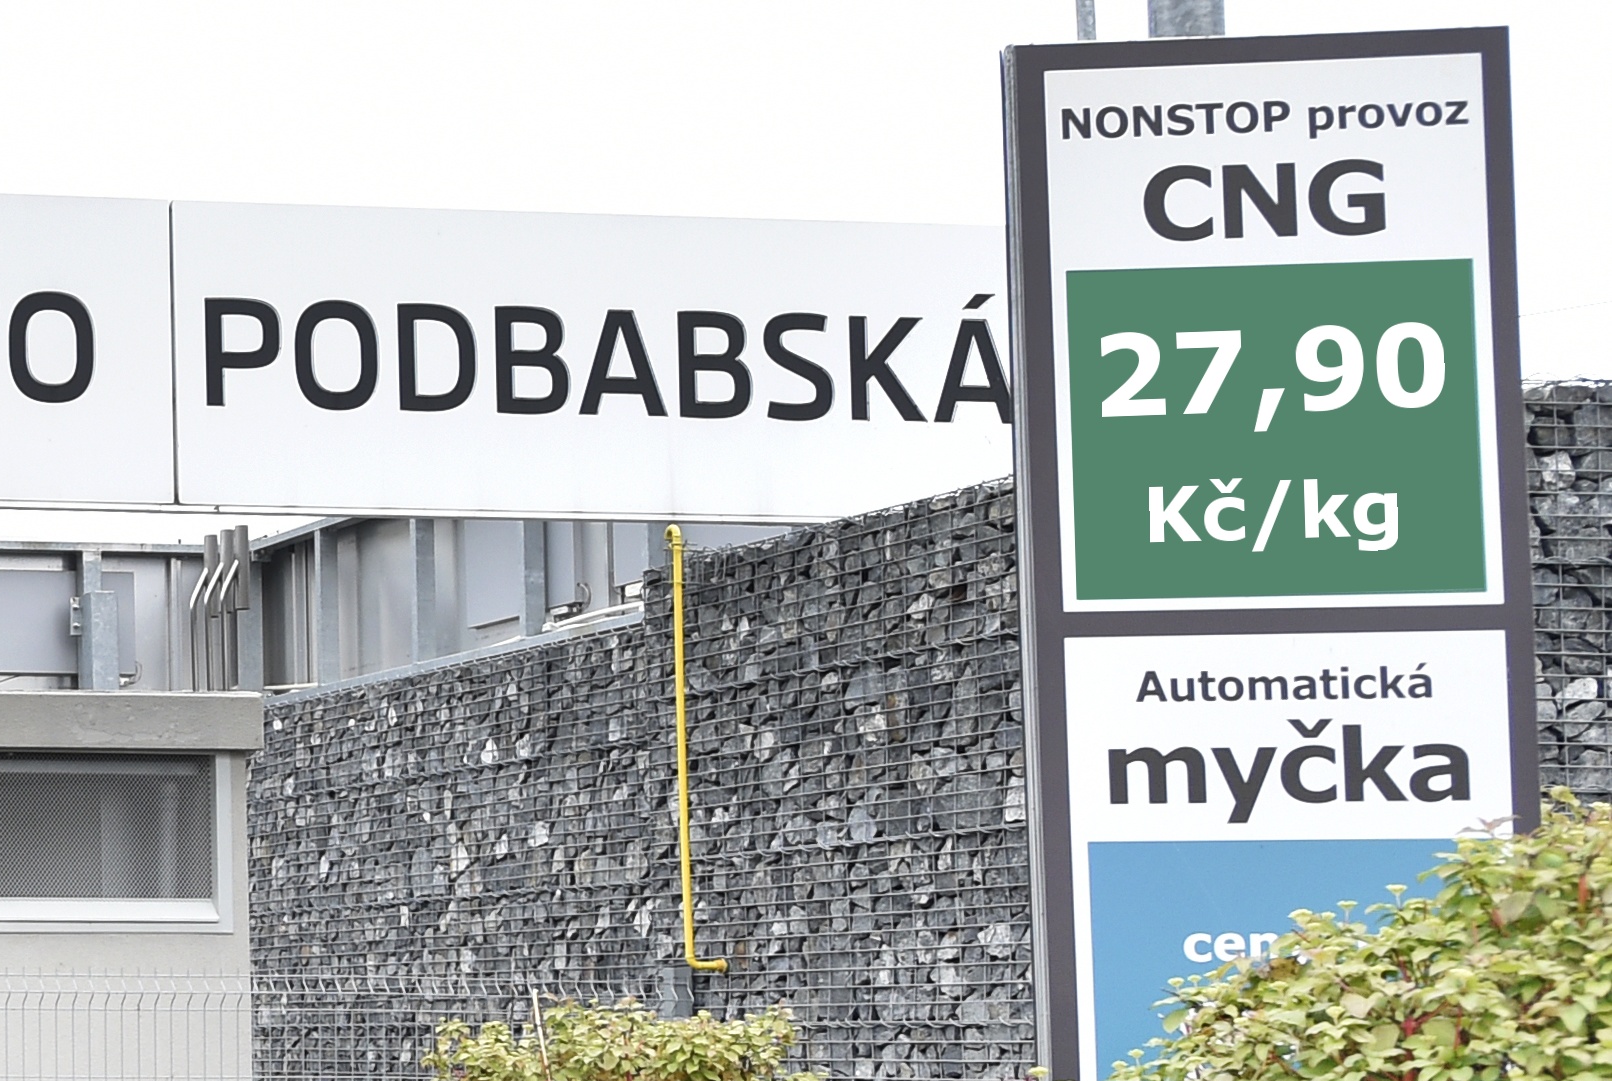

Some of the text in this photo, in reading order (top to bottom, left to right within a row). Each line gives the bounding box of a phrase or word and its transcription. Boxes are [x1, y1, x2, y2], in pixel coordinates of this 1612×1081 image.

[1061, 99, 1470, 140] NONSTOP provoz
[1142, 158, 1387, 242] CNG
[203, 293, 1015, 425] PODBABSKÁ
[1098, 321, 1447, 433] 27,90
[1147, 477, 1400, 553] Kč/kg
[1136, 662, 1433, 703] Automatická
[1106, 718, 1472, 824] myčka
